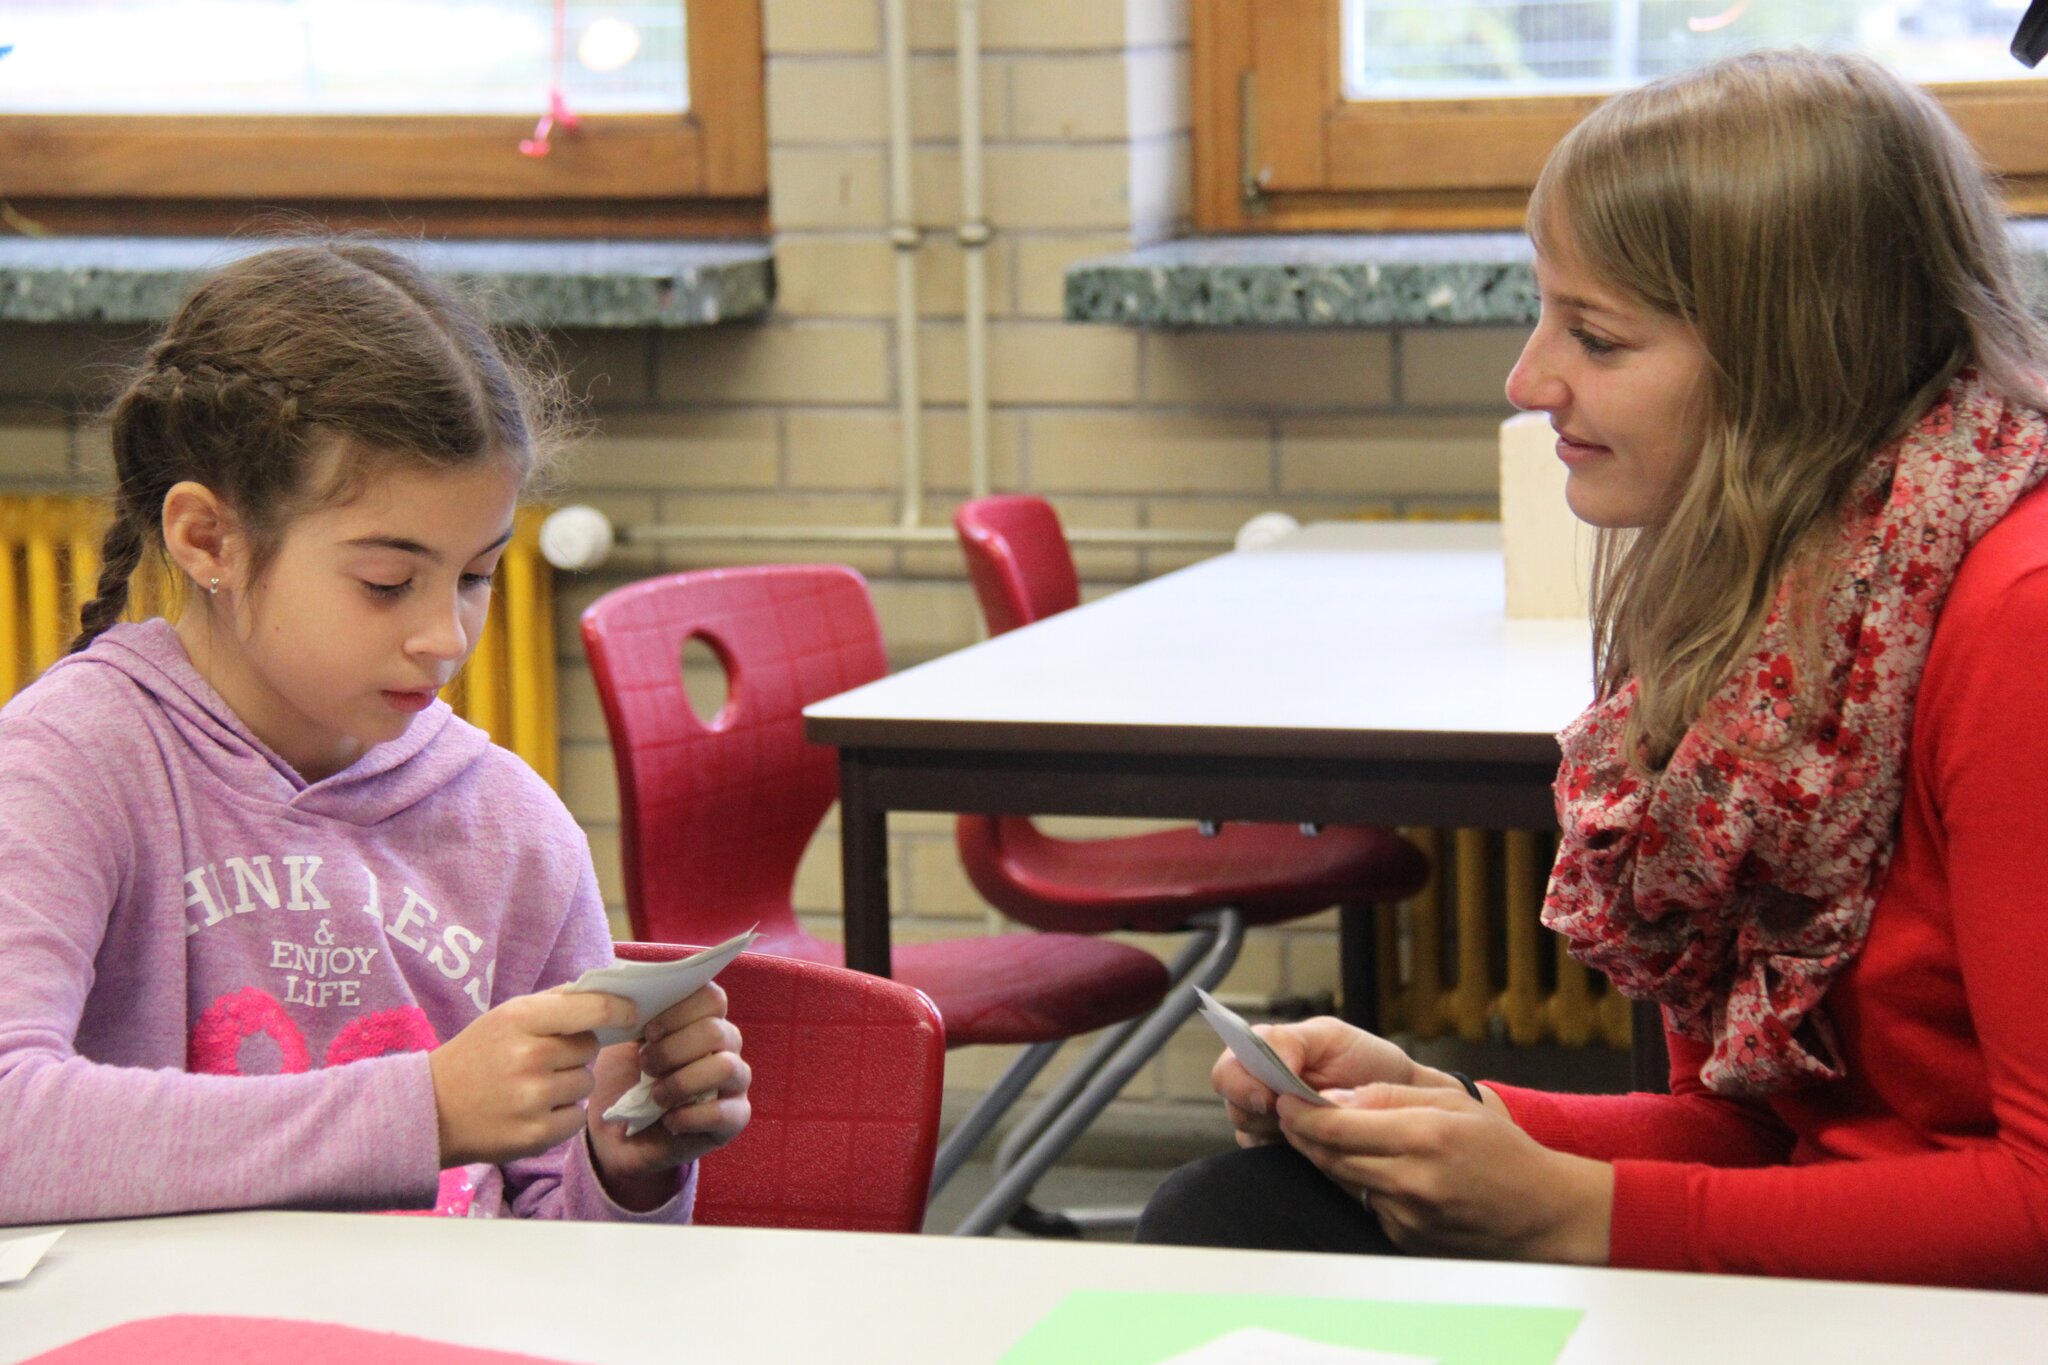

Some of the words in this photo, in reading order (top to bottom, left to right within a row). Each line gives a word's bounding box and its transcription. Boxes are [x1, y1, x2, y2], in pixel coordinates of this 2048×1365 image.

[184, 855, 331, 937] HINK
[314, 918, 335, 946] &
[270, 940, 379, 978] ENJOY
[284, 976, 360, 1008] LIFE
